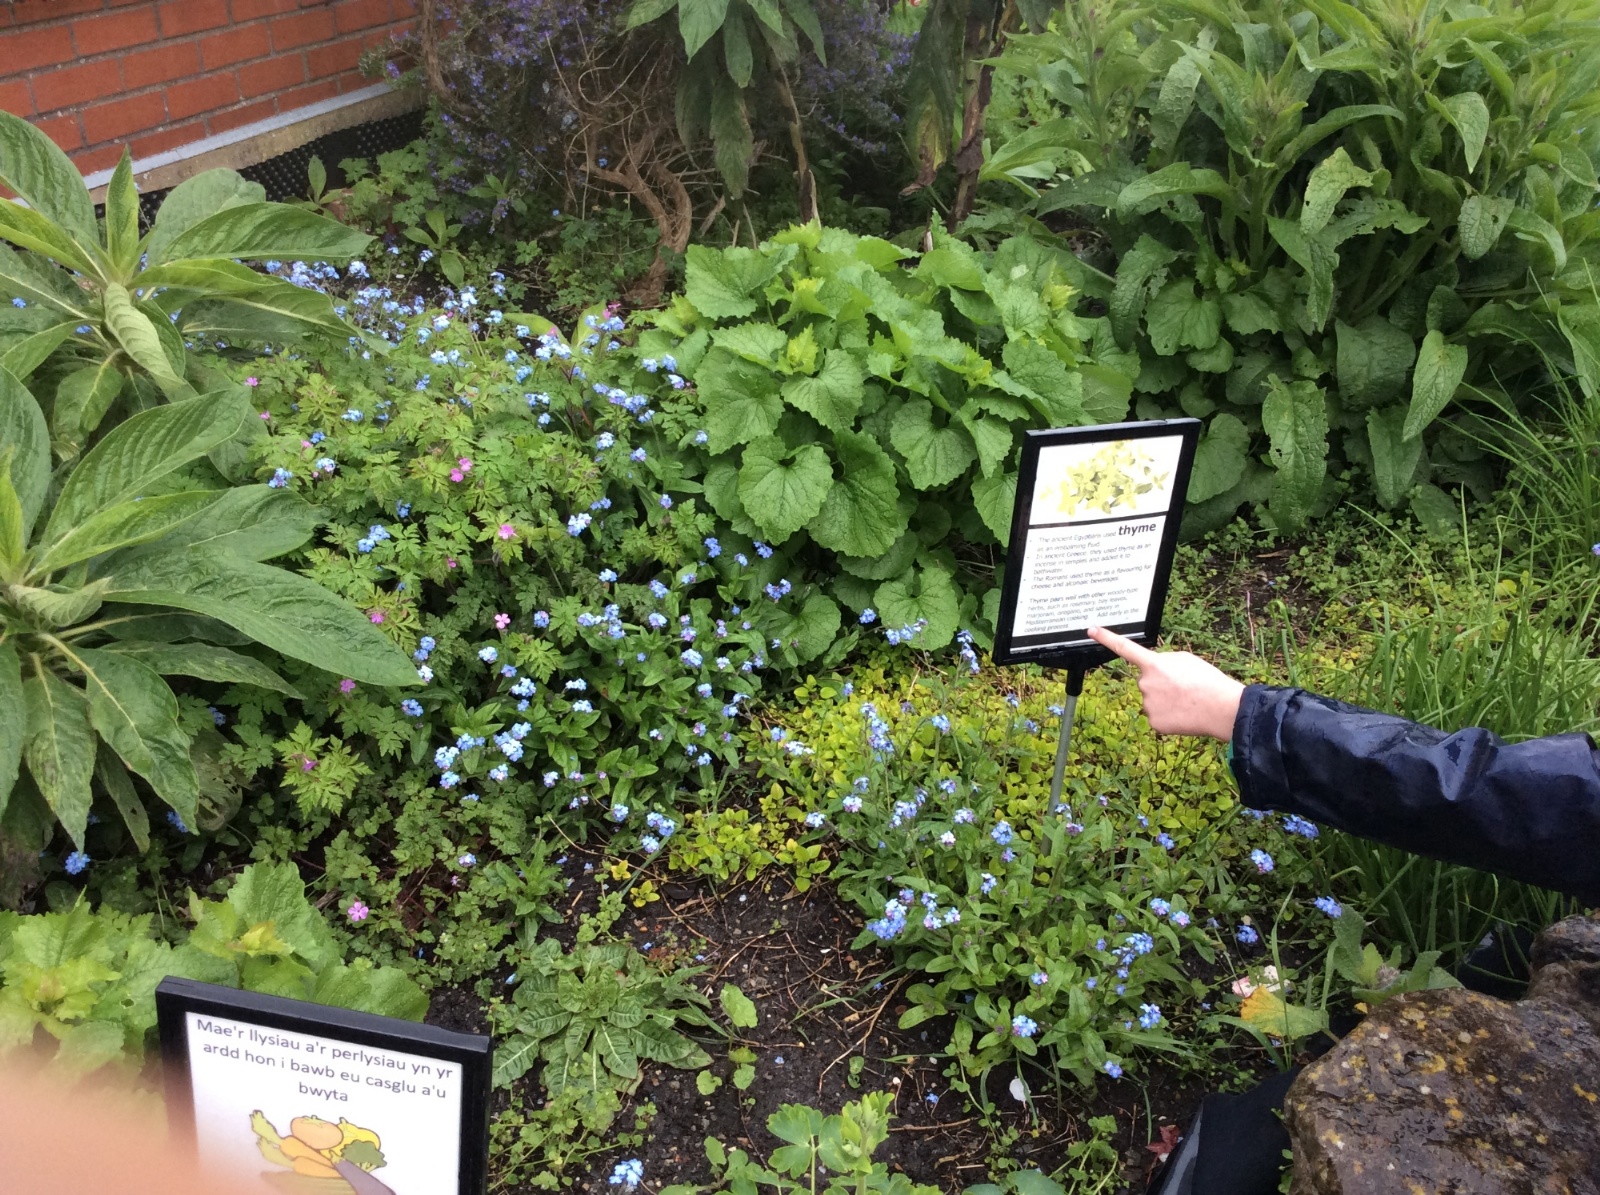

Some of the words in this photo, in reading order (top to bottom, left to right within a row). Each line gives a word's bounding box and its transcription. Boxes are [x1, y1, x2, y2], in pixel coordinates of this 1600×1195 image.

[1118, 523, 1157, 537] thyme
[197, 1018, 245, 1040] Mae'r
[249, 1028, 300, 1051] llysiau
[305, 1041, 327, 1055] a'r
[332, 1048, 406, 1071] perlysiau
[411, 1062, 431, 1076] yn
[436, 1067, 454, 1081] yr
[203, 1043, 240, 1060] ardd
[245, 1049, 276, 1067] hon
[281, 1056, 285, 1069] i
[290, 1058, 335, 1079] bawb
[340, 1070, 361, 1084] eu
[365, 1075, 417, 1094] casglu
[421, 1084, 447, 1100] a'u
[298, 1081, 349, 1103] bwyta
